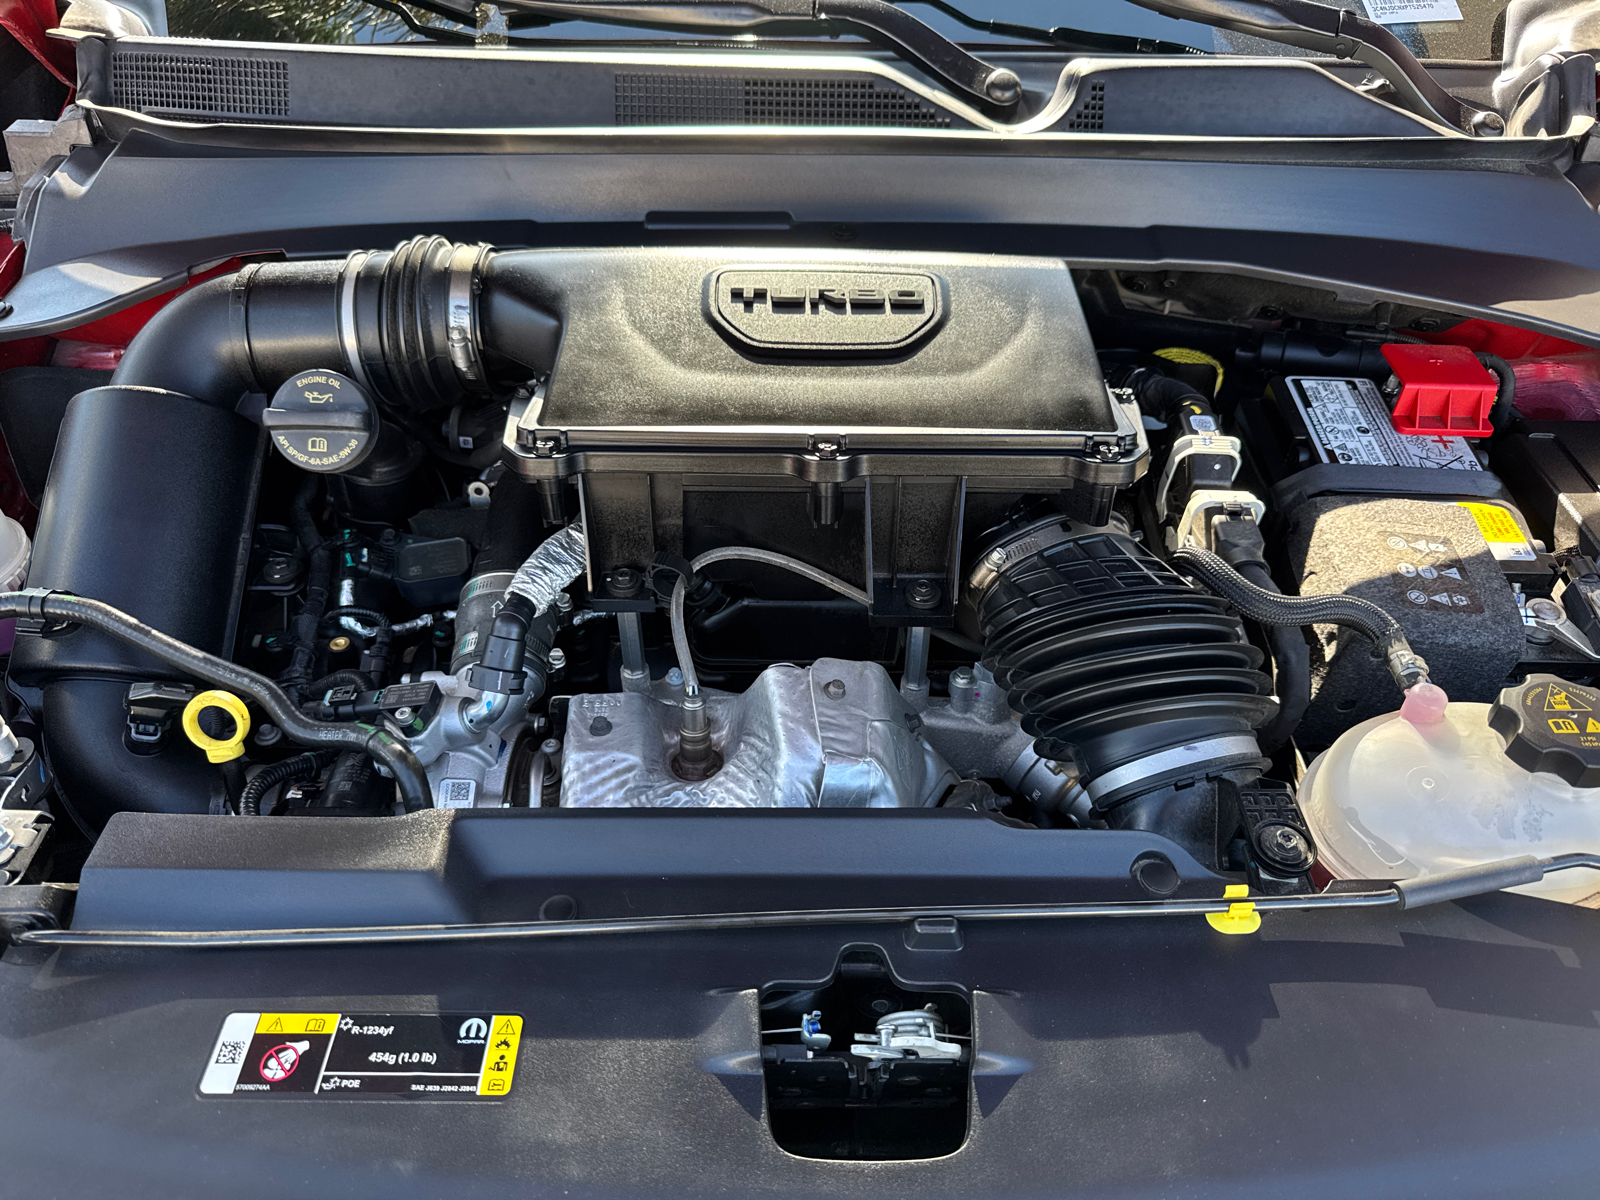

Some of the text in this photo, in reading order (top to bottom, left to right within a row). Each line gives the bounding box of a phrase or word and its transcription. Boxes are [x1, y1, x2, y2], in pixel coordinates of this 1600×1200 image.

[730, 286, 924, 306] TURBO
[296, 376, 341, 389] ENGINE OIL
[277, 435, 290, 449] API
[351, 1026, 395, 1036] R-1234yf
[368, 1052, 437, 1064] 454g (1.0 lb)
[341, 1079, 361, 1088] POE
